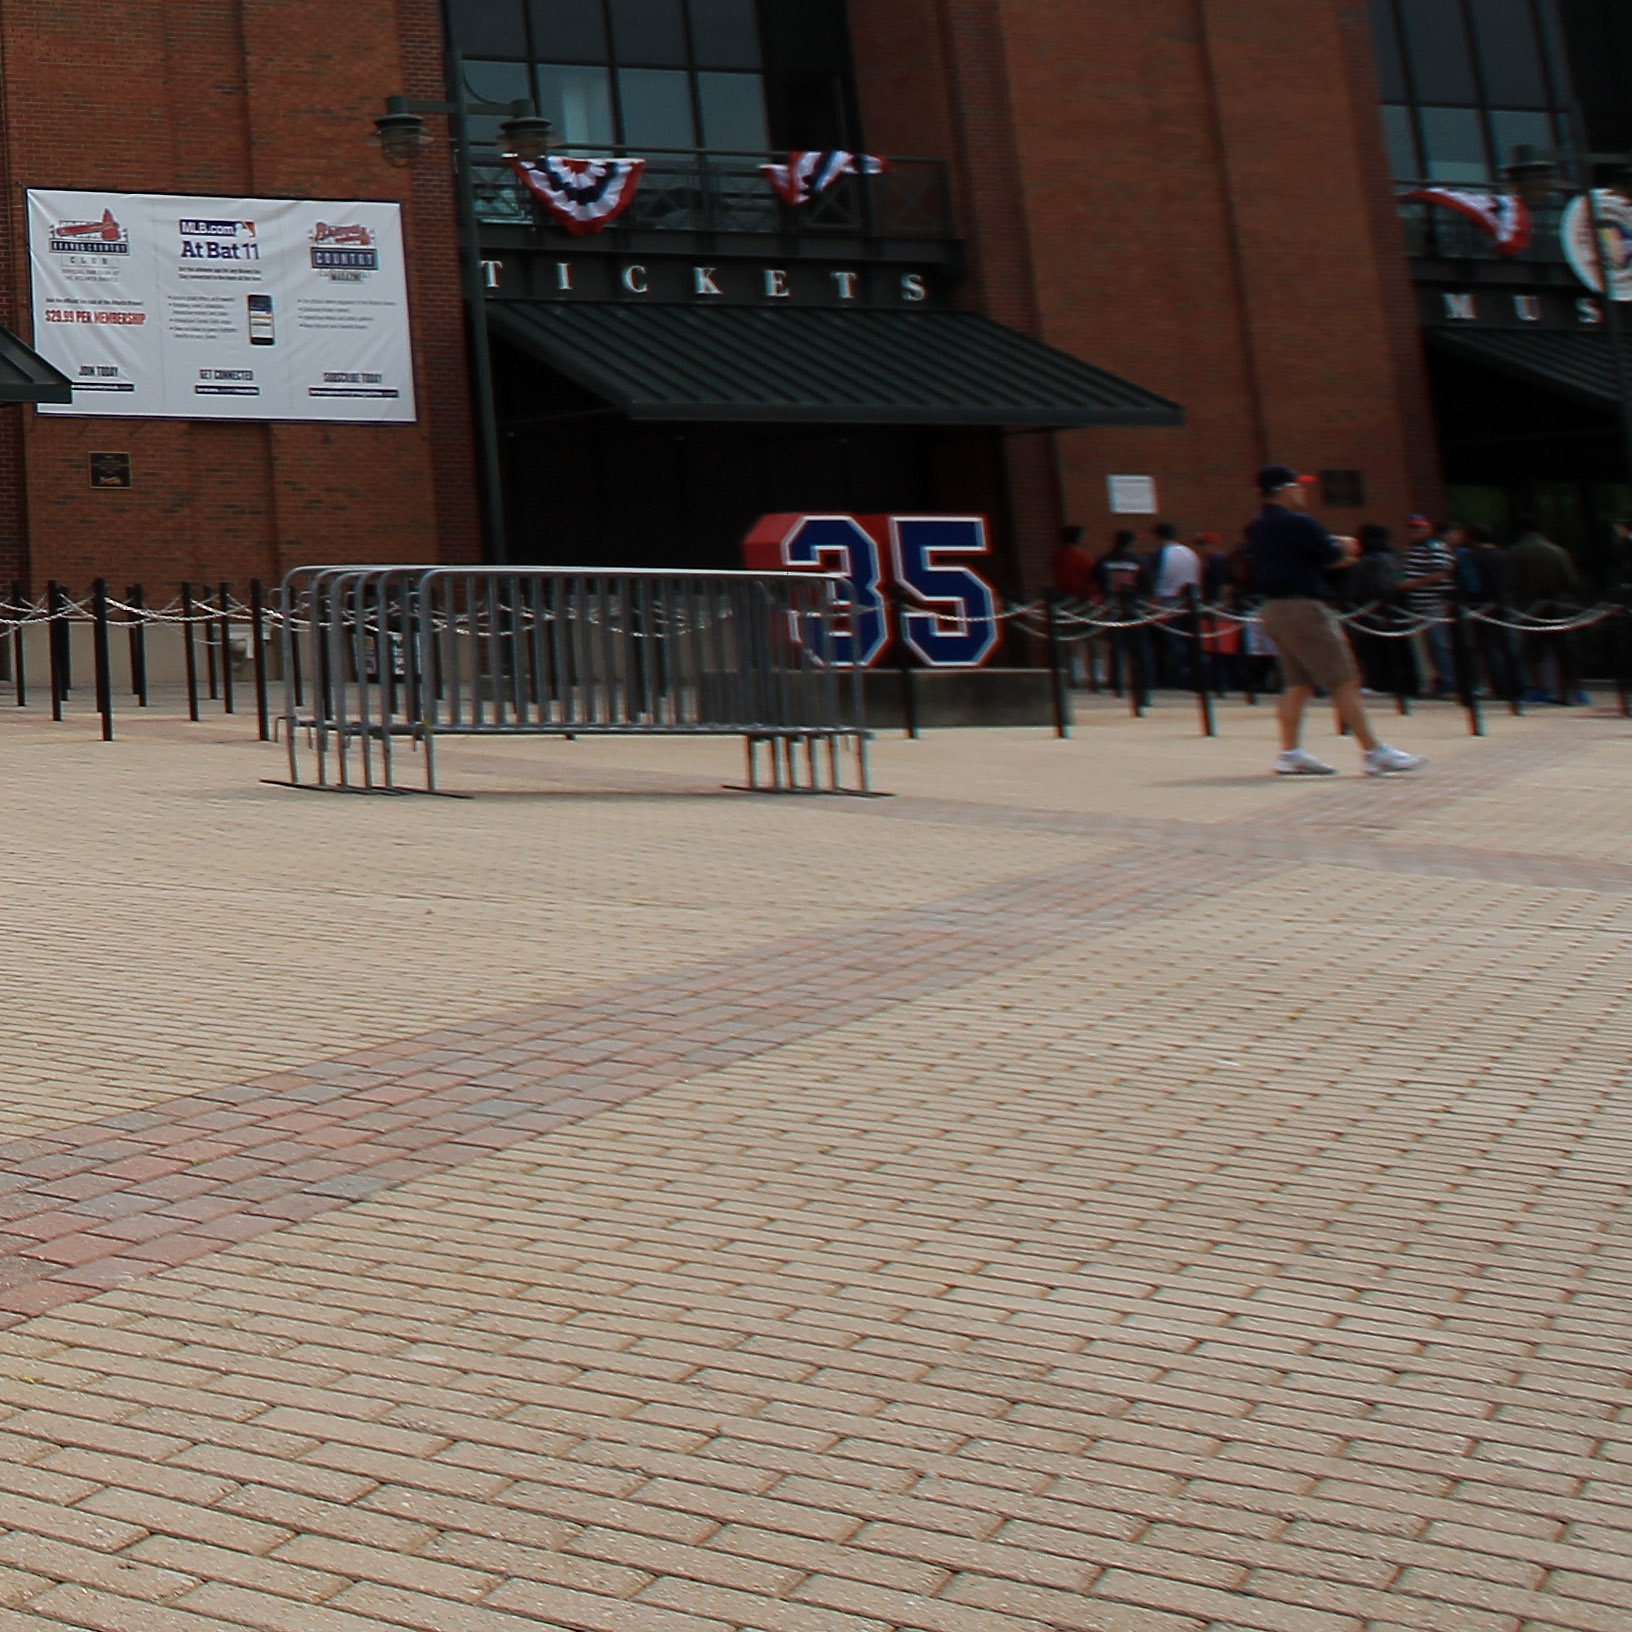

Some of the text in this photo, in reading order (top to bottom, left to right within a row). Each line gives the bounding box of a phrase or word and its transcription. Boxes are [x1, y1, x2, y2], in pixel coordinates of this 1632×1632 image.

[181, 221, 234, 234] MLB.com
[181, 240, 260, 260] At Bat 11
[316, 252, 374, 266] COUNTRY
[480, 260, 926, 302] TICKETS
[776, 513, 1006, 670] 35
